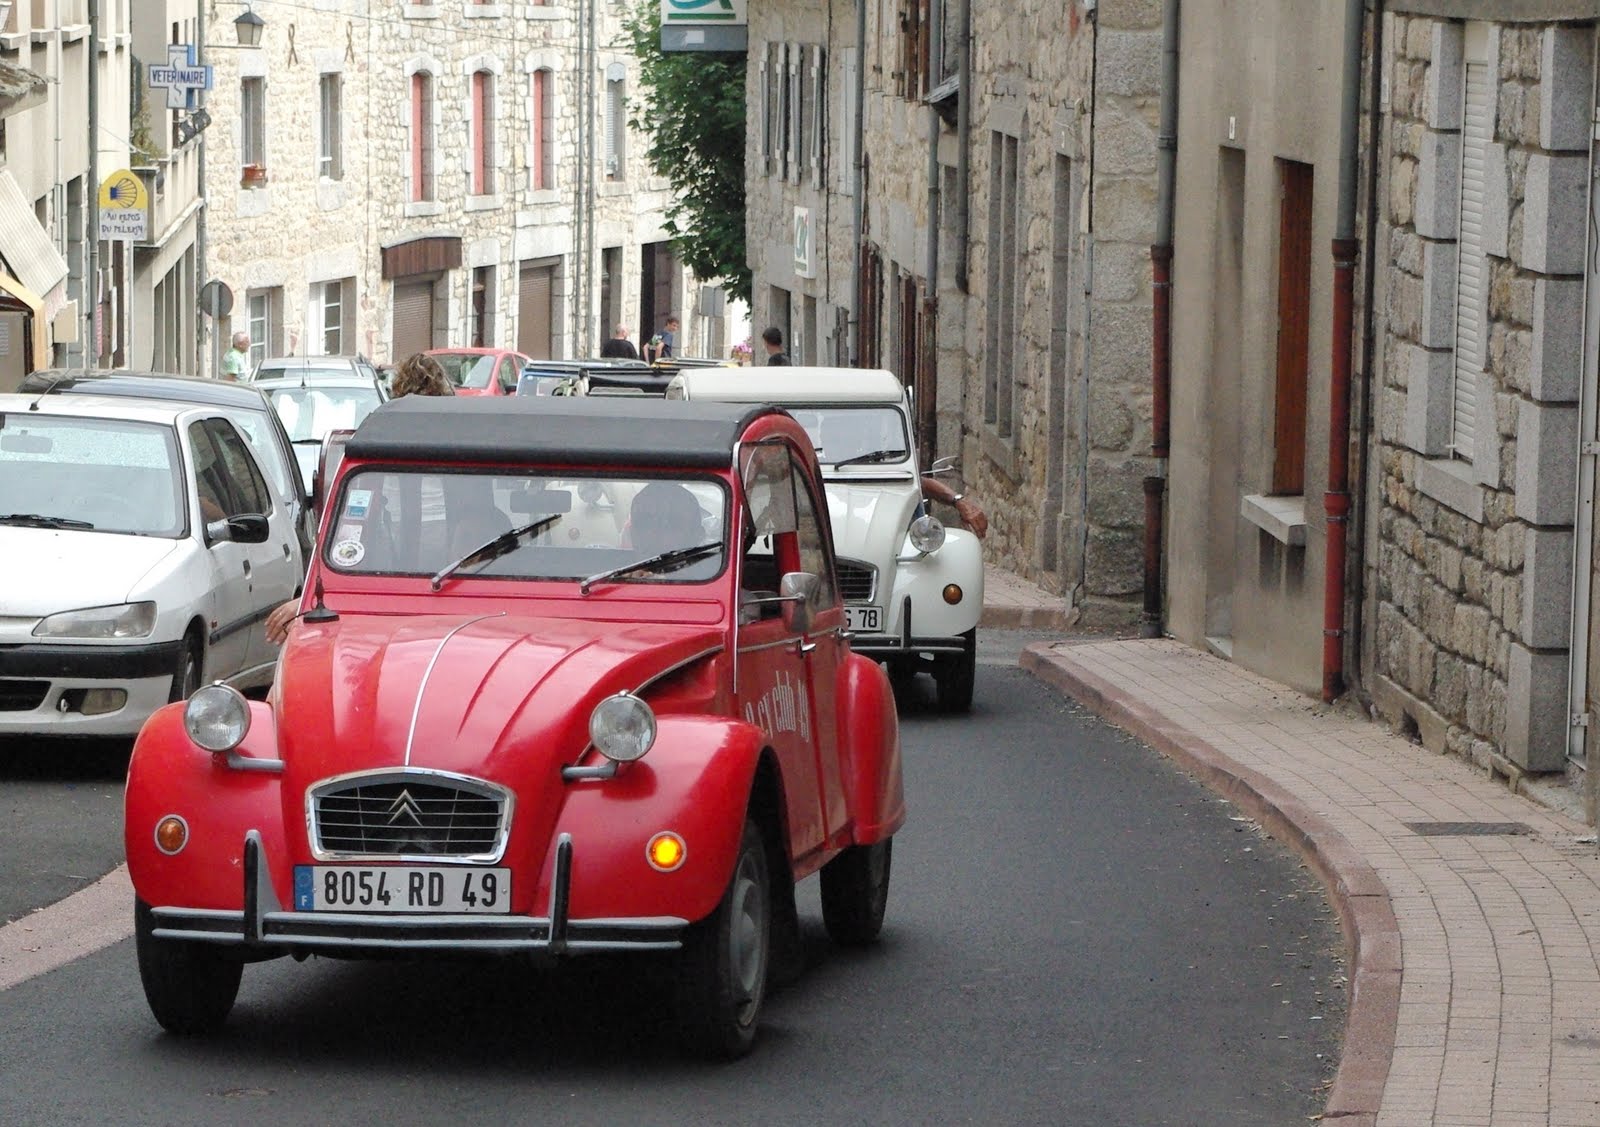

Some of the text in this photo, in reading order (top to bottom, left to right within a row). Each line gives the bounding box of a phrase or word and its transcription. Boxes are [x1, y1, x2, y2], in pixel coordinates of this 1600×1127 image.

[152, 69, 204, 84] VETERINAIRE
[101, 224, 112, 233] DU
[858, 609, 878, 628] 78
[301, 870, 498, 908] F 8054 RD 49
